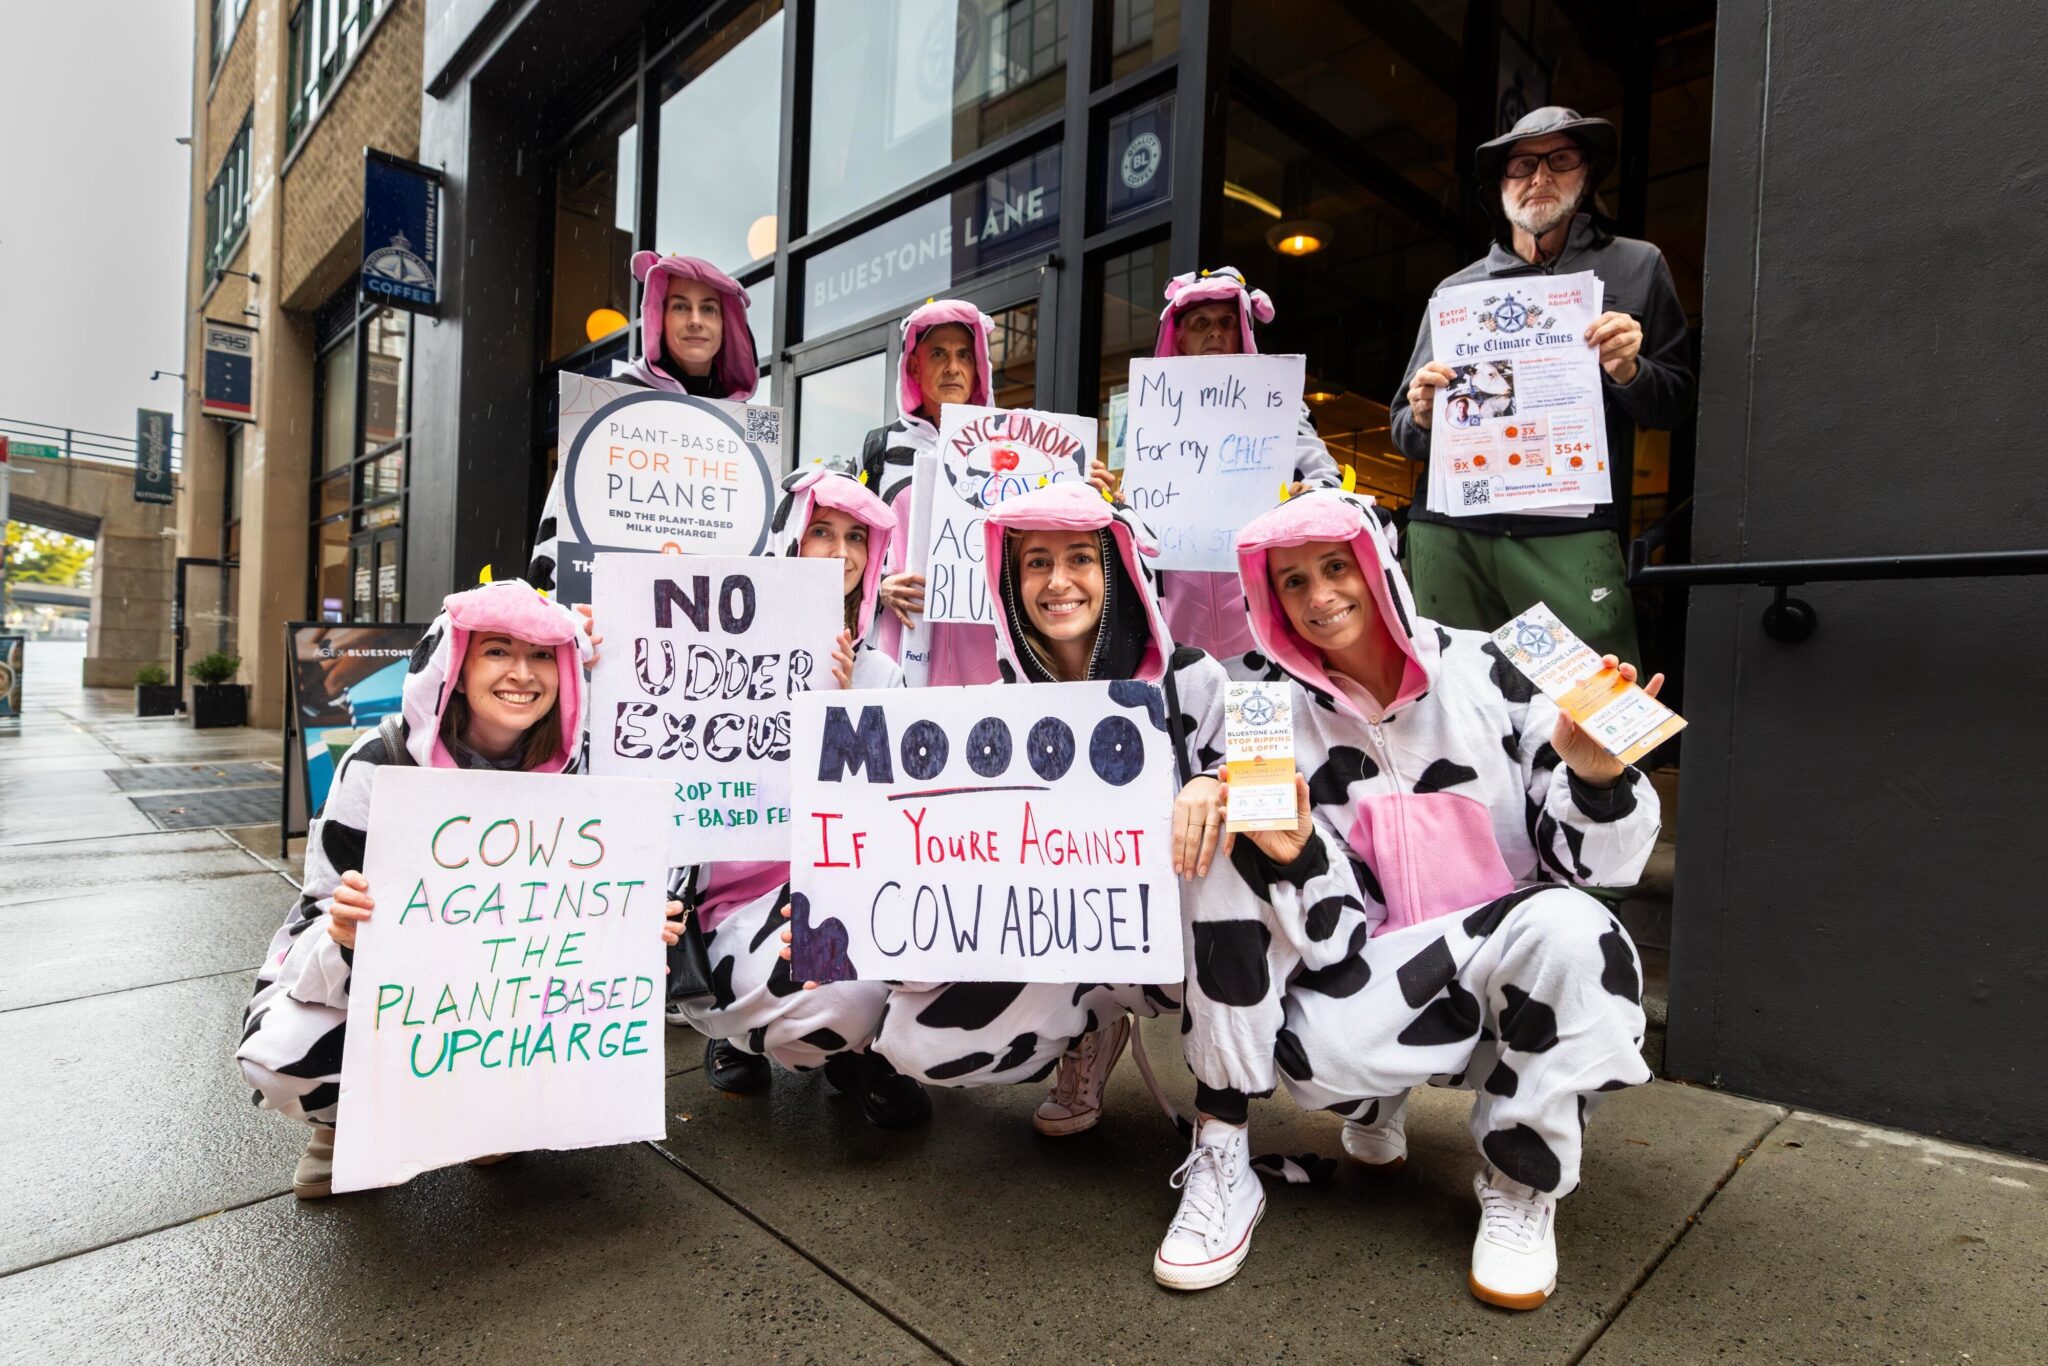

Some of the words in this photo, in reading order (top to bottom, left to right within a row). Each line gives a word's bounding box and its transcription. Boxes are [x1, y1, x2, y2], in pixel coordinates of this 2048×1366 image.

[1127, 136, 1156, 157] QUALITY
[1133, 152, 1149, 169] BL
[1127, 167, 1153, 184] COFFEE
[426, 180, 435, 204] LANE
[425, 206, 435, 261] BLUESTONE
[814, 224, 952, 307] BLUESTONE
[964, 186, 1044, 247] LANE
[368, 279, 432, 304] COFFEE
[1548, 292, 1568, 300] Read
[1548, 299, 1571, 307] About
[1439, 306, 1467, 319] Extra!
[1440, 314, 1467, 327] Extra!
[211, 331, 248, 351] F45
[1455, 343, 1480, 356] The
[1484, 337, 1531, 352] Climate
[1535, 332, 1573, 345] Times
[1139, 371, 1183, 426] My
[1200, 374, 1247, 410] milk
[1266, 384, 1283, 408] is
[609, 422, 739, 454] PLANT-BASED
[951, 416, 991, 457] NYC
[1008, 415, 1079, 458] UNION
[1521, 427, 1536, 436] 3X
[1136, 427, 1171, 461] for
[1180, 439, 1208, 474] my
[1218, 433, 1280, 465] CALF
[1555, 443, 1592, 455] 354+
[608, 446, 670, 473] FOR
[684, 457, 739, 482] THE
[1454, 461, 1469, 470] 9X
[607, 473, 738, 513] PLANET
[981, 471, 1064, 506] CO
[1132, 481, 1180, 510] not
[1505, 482, 1536, 491] Bluestone
[609, 509, 631, 519] END
[634, 512, 656, 522] THE
[659, 514, 734, 530] PLANT-BASED
[626, 523, 652, 533] MILK
[655, 525, 717, 539] UPCHARGE!
[932, 518, 984, 562] AG
[1208, 528, 1238, 552] ST
[572, 560, 594, 573] TH
[654, 574, 756, 634] NO
[930, 564, 993, 620] BLU
[348, 649, 412, 657] BLUESTONE
[634, 637, 813, 701] UDDER
[1529, 655, 1565, 679] BLUESTONE
[1536, 670, 1557, 686] STOP
[1558, 648, 1591, 671] RIPPING
[614, 702, 791, 762] EXCUS
[817, 705, 1145, 787] MOOOO
[1256, 744, 1278, 752] OFF!
[675, 782, 712, 802] ROP
[717, 781, 757, 799] THE
[673, 807, 759, 828] T-BASED
[766, 806, 791, 825] FE
[431, 815, 605, 870] COWS
[811, 812, 867, 869] IF
[1020, 802, 1145, 866] AGAINST
[399, 878, 645, 925] AGAINST
[871, 881, 983, 957] COW
[1000, 884, 1150, 957] ABUSE!
[482, 932, 586, 972] THE
[375, 976, 653, 1030] PLANT-BASED
[410, 1020, 648, 1078] UPCHARGE
